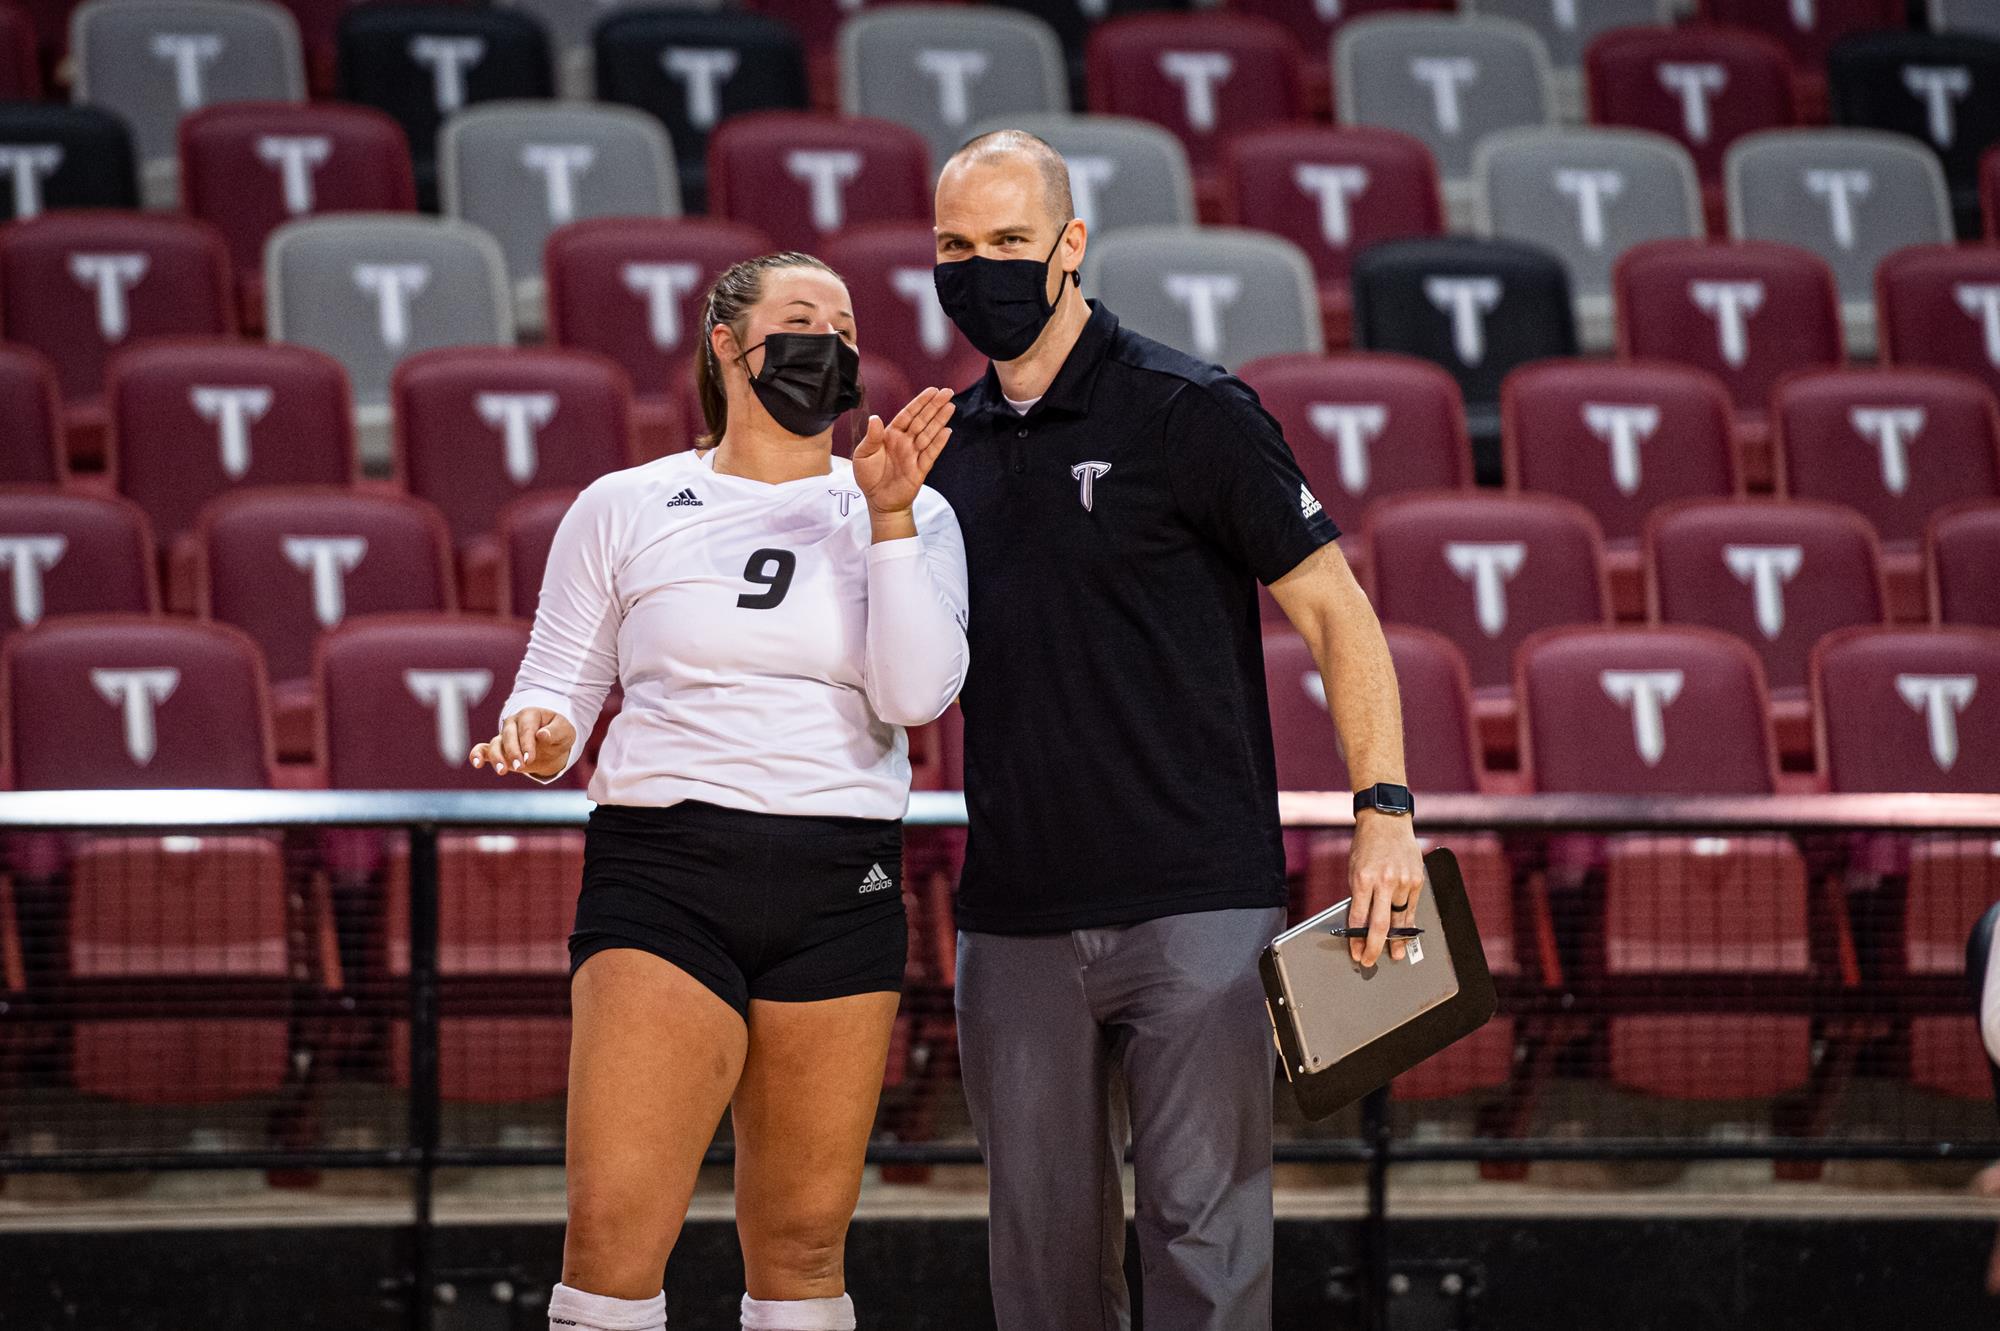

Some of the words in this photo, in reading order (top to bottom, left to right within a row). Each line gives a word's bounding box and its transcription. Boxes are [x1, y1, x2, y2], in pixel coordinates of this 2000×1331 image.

[154, 35, 221, 109] T
[412, 36, 485, 114] T
[666, 49, 735, 127] T
[919, 50, 986, 125] T
[1163, 52, 1231, 129] T
[1412, 58, 1476, 134] T
[1660, 64, 1725, 141] T
[1905, 67, 1970, 145] T
[0, 146, 62, 221] T
[259, 136, 329, 215] T
[524, 145, 593, 222] T
[789, 151, 860, 230] T
[1297, 165, 1367, 244] T
[1556, 170, 1621, 248] T
[1805, 170, 1870, 249] T
[72, 254, 146, 338] T
[355, 265, 427, 347] T
[625, 264, 699, 347] T
[892, 267, 953, 356] T
[1167, 274, 1238, 355] T
[1428, 278, 1500, 362] T
[1692, 281, 1763, 365] T
[192, 387, 271, 475] T
[478, 393, 555, 480] T
[1311, 405, 1386, 491] T
[1584, 404, 1659, 491] T
[1852, 408, 1924, 493] T
[666, 498, 703, 507] adidas
[828, 489, 861, 517] T
[1070, 460, 1112, 512] T
[1302, 500, 1322, 519] adidas
[0, 536, 64, 625] T
[284, 537, 365, 626] T
[736, 547, 797, 610] 9
[1447, 543, 1525, 634] T
[1726, 546, 1802, 636] T
[93, 668, 178, 762] T
[406, 670, 491, 764] T
[1601, 670, 1683, 763] T
[1897, 675, 1976, 767] T
[858, 879, 892, 894] adidas
